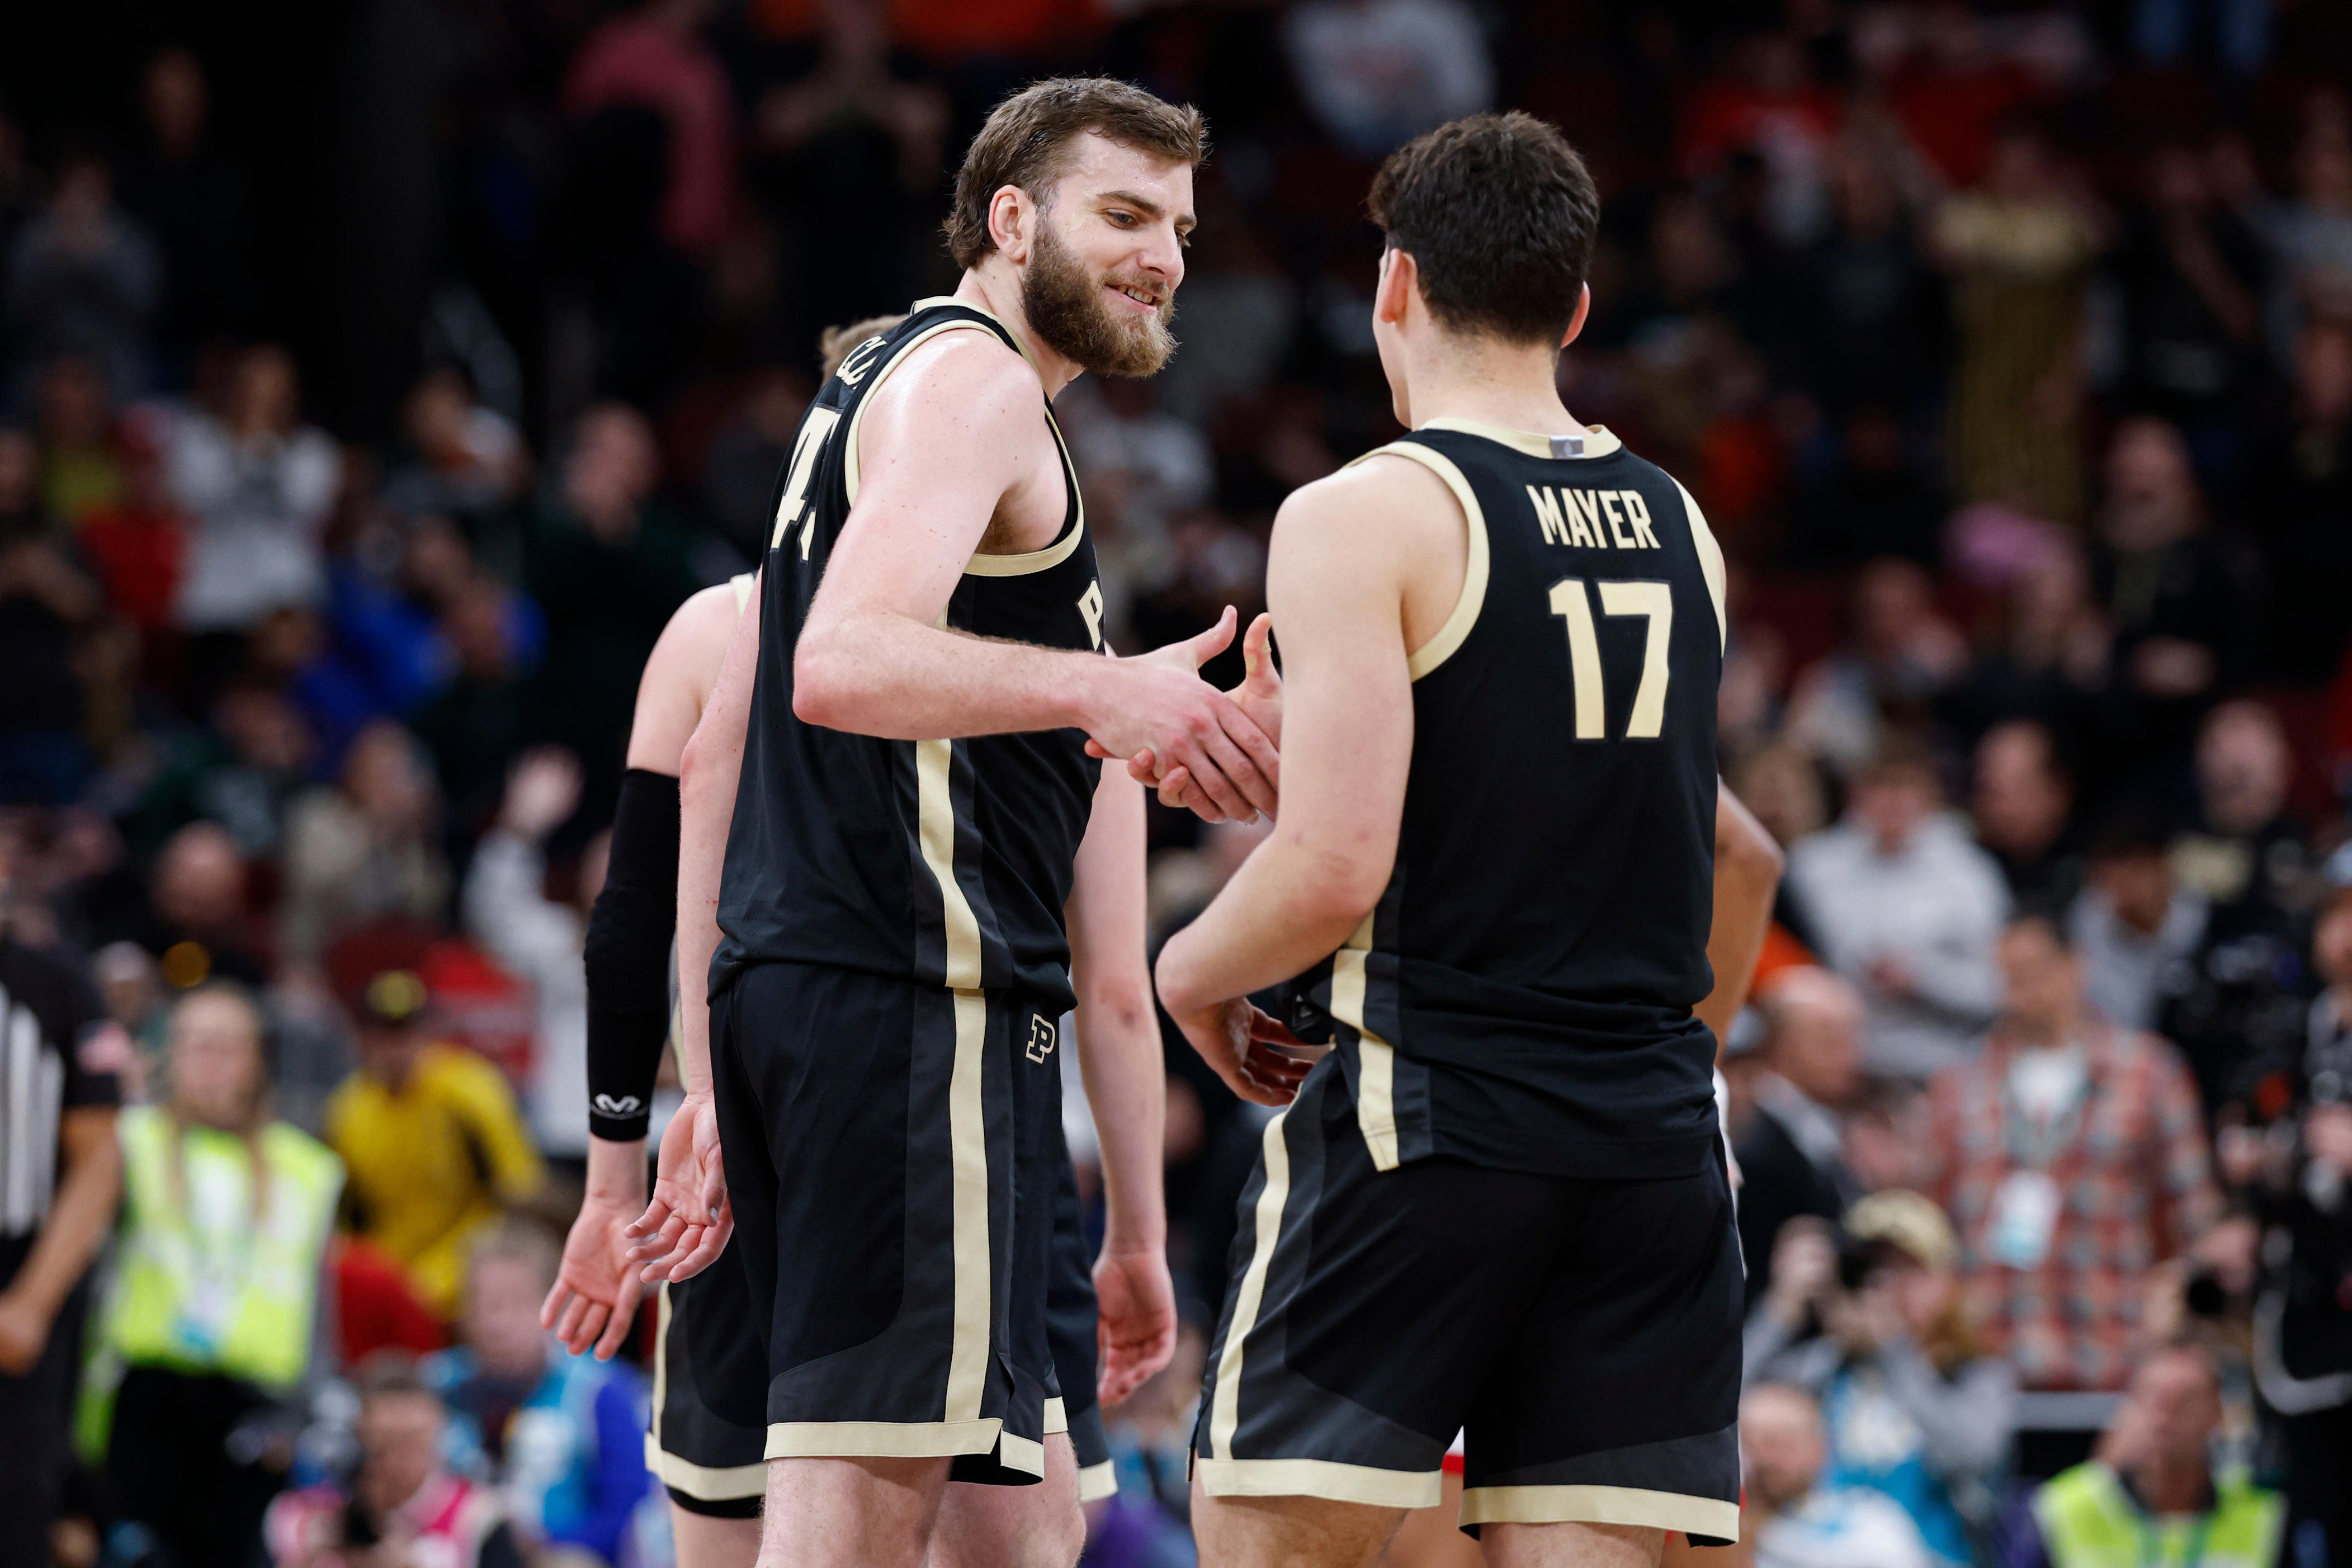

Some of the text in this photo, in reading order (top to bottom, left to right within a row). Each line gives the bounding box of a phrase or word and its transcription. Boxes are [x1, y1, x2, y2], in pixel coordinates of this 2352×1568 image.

[1526, 484, 1662, 549] MAYER
[1547, 578, 1673, 740] 17
[1025, 1012, 1056, 1064] P
